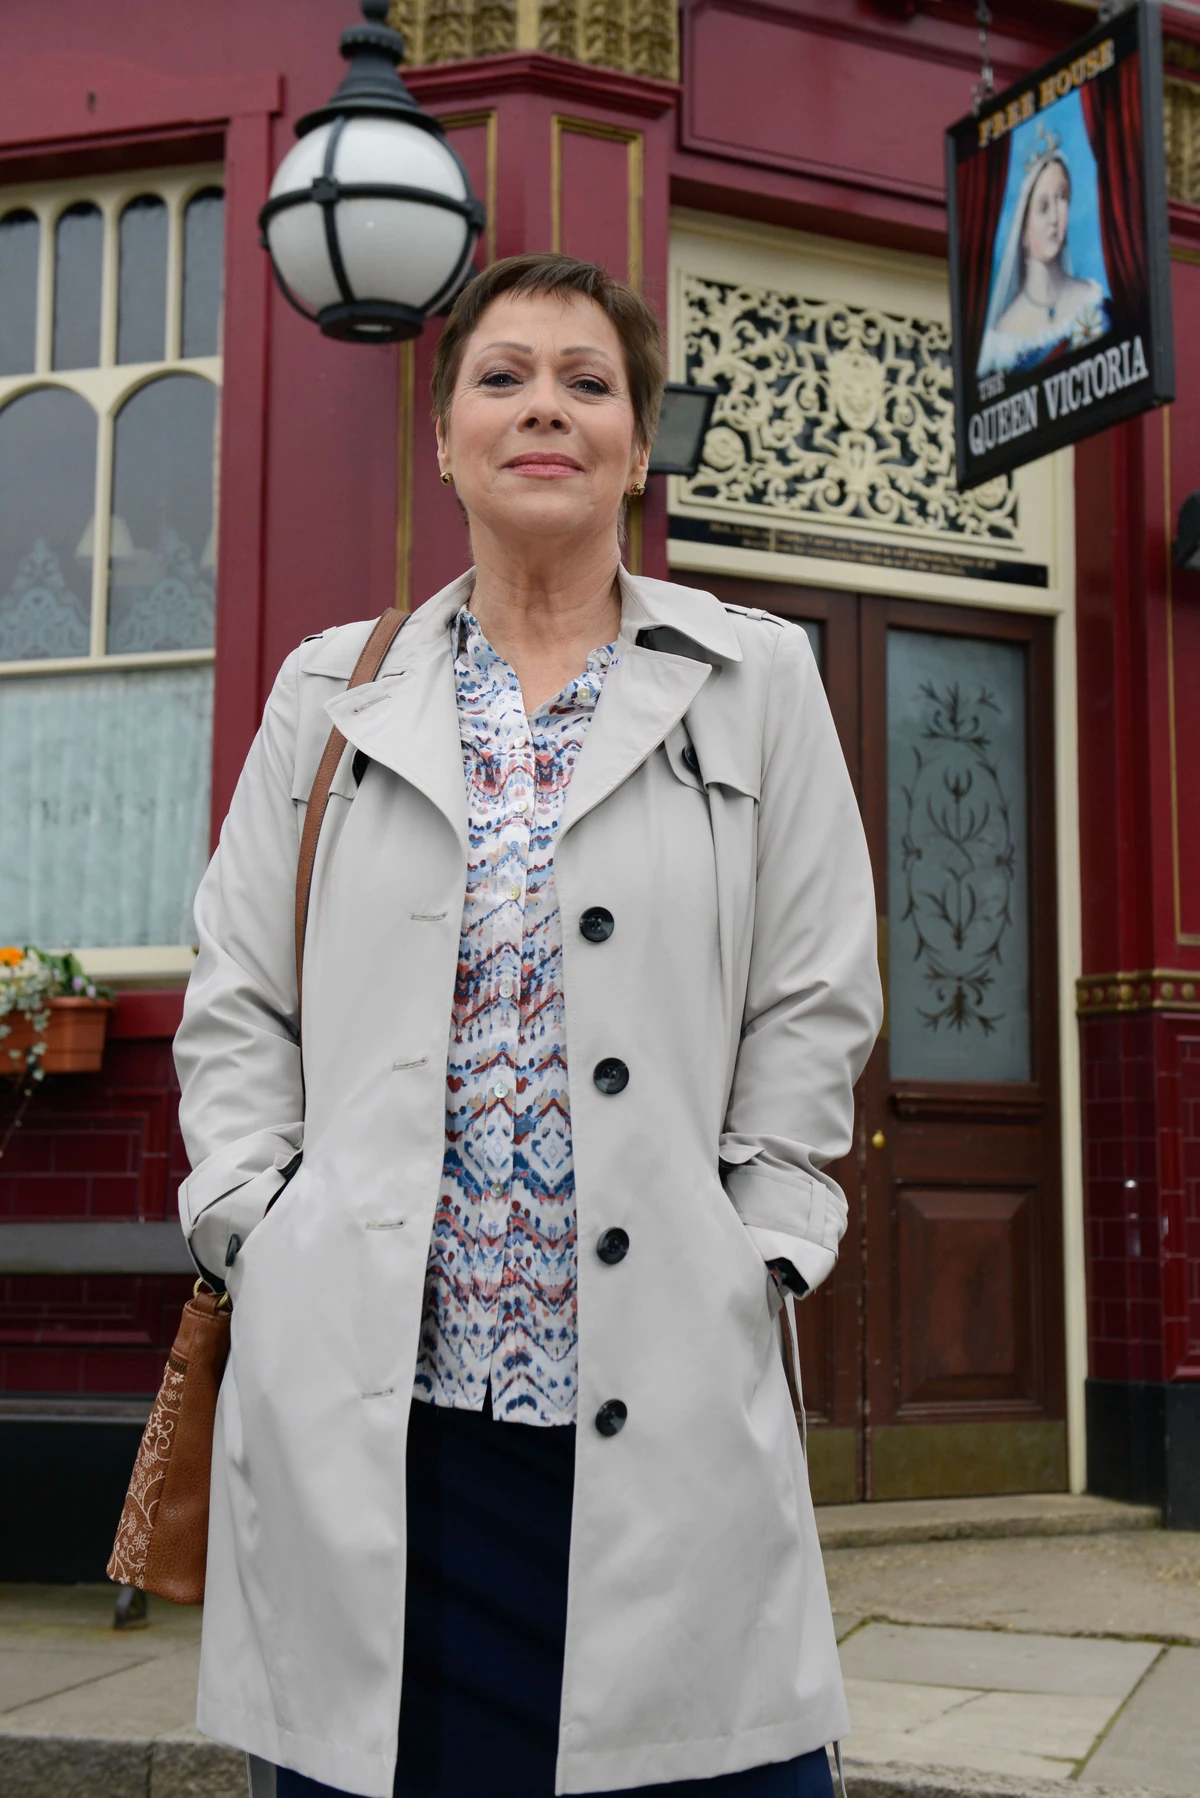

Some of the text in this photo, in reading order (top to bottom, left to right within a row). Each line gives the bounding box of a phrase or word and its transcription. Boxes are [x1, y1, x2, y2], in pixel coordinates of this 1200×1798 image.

[977, 37, 1115, 148] FREE HOUSE
[968, 335, 1150, 456] QUEEN VICTORIA
[977, 371, 1005, 402] THE
